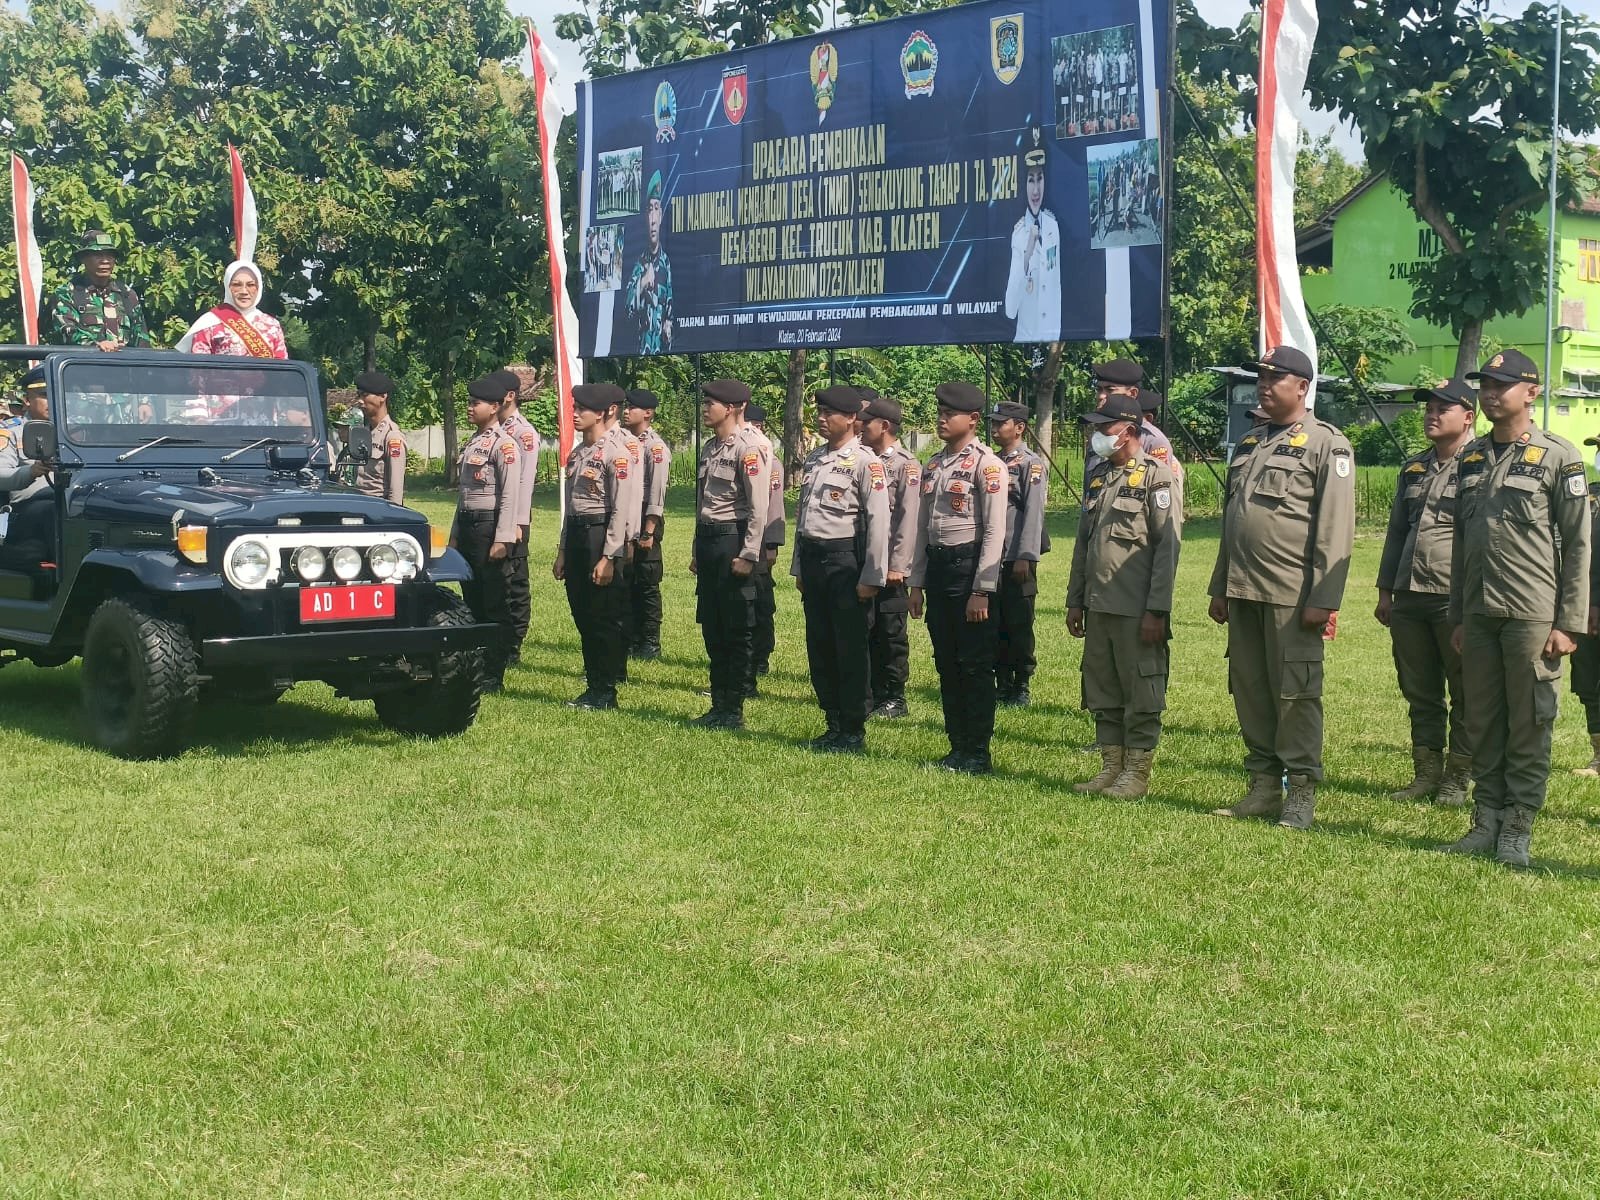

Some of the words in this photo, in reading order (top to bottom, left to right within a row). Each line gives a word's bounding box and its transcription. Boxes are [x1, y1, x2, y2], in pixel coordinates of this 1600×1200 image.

[753, 135, 807, 180] UPACARA
[810, 124, 885, 172] PEMBUKAAN
[671, 196, 684, 233] TNI
[687, 189, 734, 231] MANUNGGAL
[738, 182, 788, 225] MEMBANGUN
[792, 178, 814, 219] DESA
[818, 172, 854, 219] (TMMD)
[859, 167, 923, 213] SENGKUYUNG
[928, 162, 960, 206] TAHAP
[964, 161, 968, 204] I
[974, 159, 989, 202] TA.
[992, 155, 1018, 200] 2024
[721, 230, 746, 266] DESA
[750, 227, 776, 262] BERO
[782, 224, 806, 260] KEC.
[810, 219, 854, 257] TRUCUK
[859, 217, 887, 253] KAB.
[891, 212, 939, 251] KLATEN
[746, 265, 785, 302] WILAYAH
[788, 263, 818, 299] KODIM
[820, 258, 884, 297] 0723/KLATEN
[1389, 263, 1395, 279] 2
[708, 315, 730, 326] BAKTI
[757, 310, 812, 323] MEWUJUDKAN
[816, 306, 866, 320] PERCEPATAN
[870, 304, 937, 318] PEMBANGUNAN
[943, 304, 952, 315] DI
[957, 301, 1003, 314] WILAYAH"
[797, 328, 804, 342] 20
[805, 328, 827, 342] Februari
[827, 327, 841, 341] 2024
[831, 466, 854, 476] POLRI
[951, 470, 971, 480] POLRI
[313, 592, 333, 613] AD
[349, 591, 355, 611] 1
[374, 590, 383, 609] C
